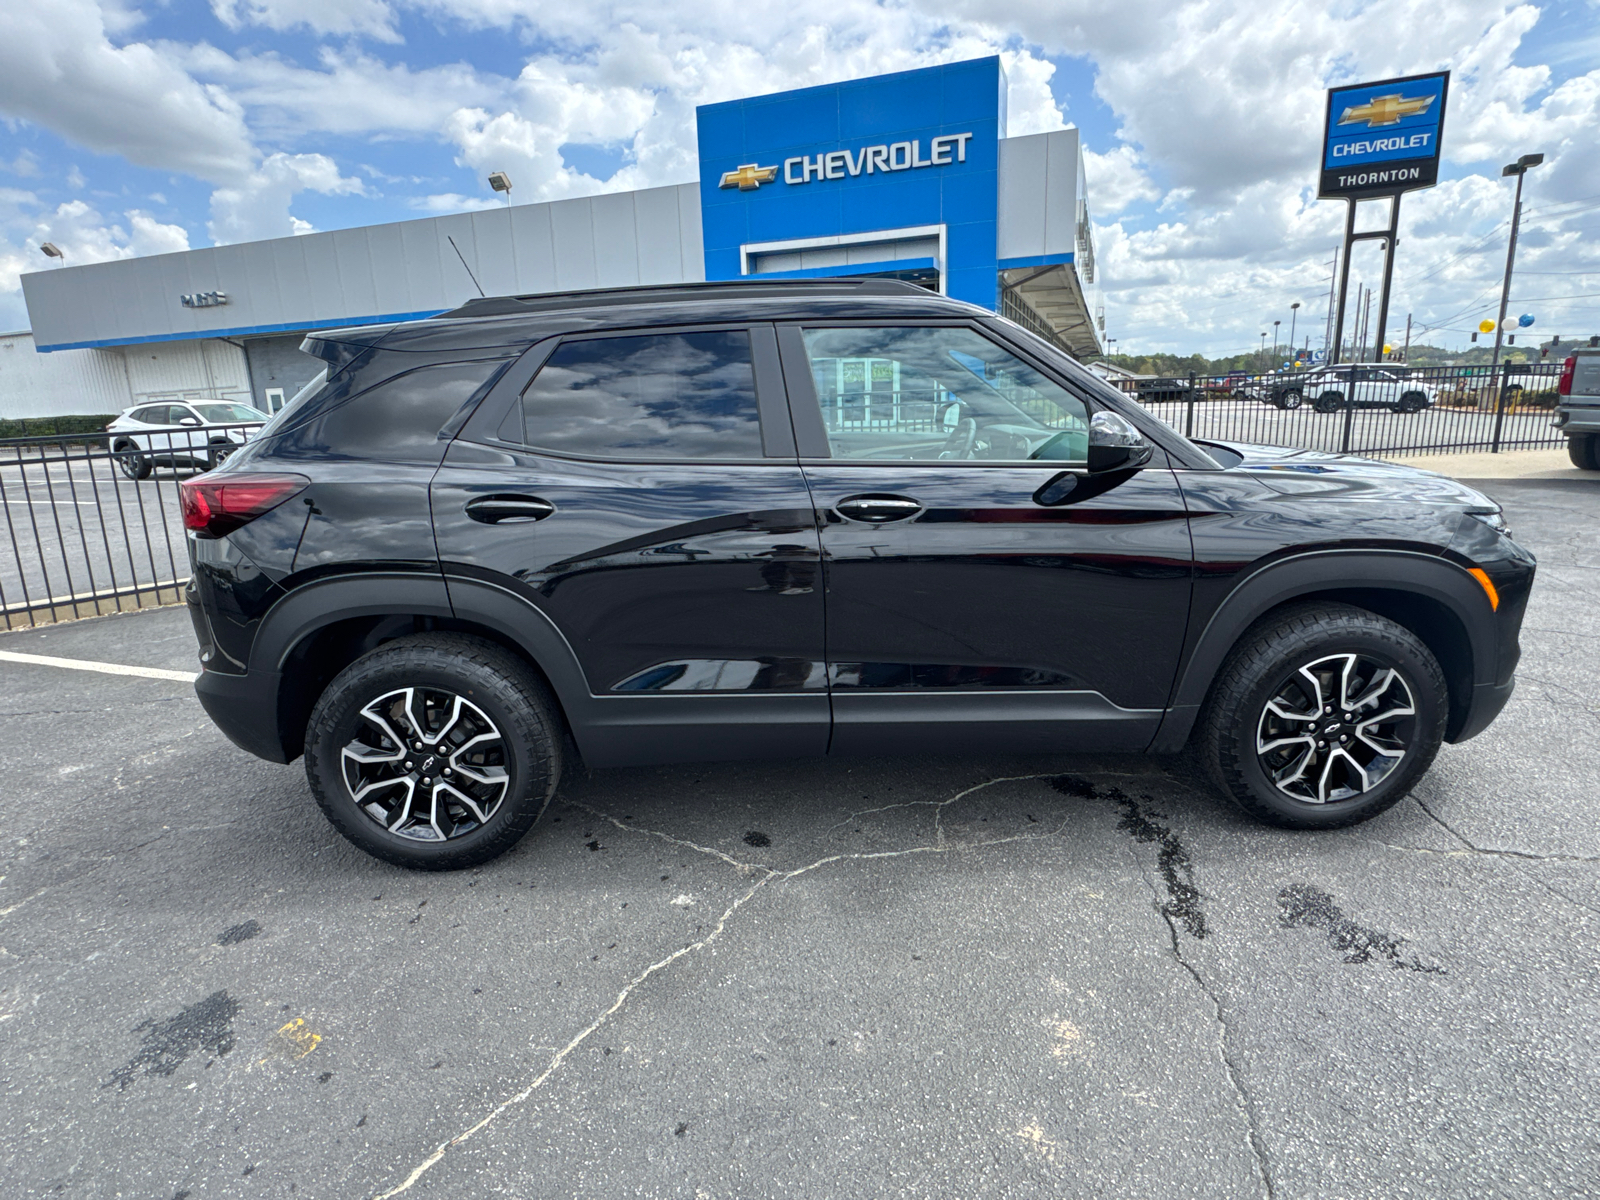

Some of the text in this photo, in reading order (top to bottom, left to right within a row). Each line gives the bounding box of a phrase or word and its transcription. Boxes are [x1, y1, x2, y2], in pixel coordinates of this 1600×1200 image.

[1332, 133, 1432, 157] CHEVROLET
[783, 132, 973, 185] CHEVROLET
[1338, 167, 1420, 187] THORNTON
[180, 291, 226, 308] PARTS
